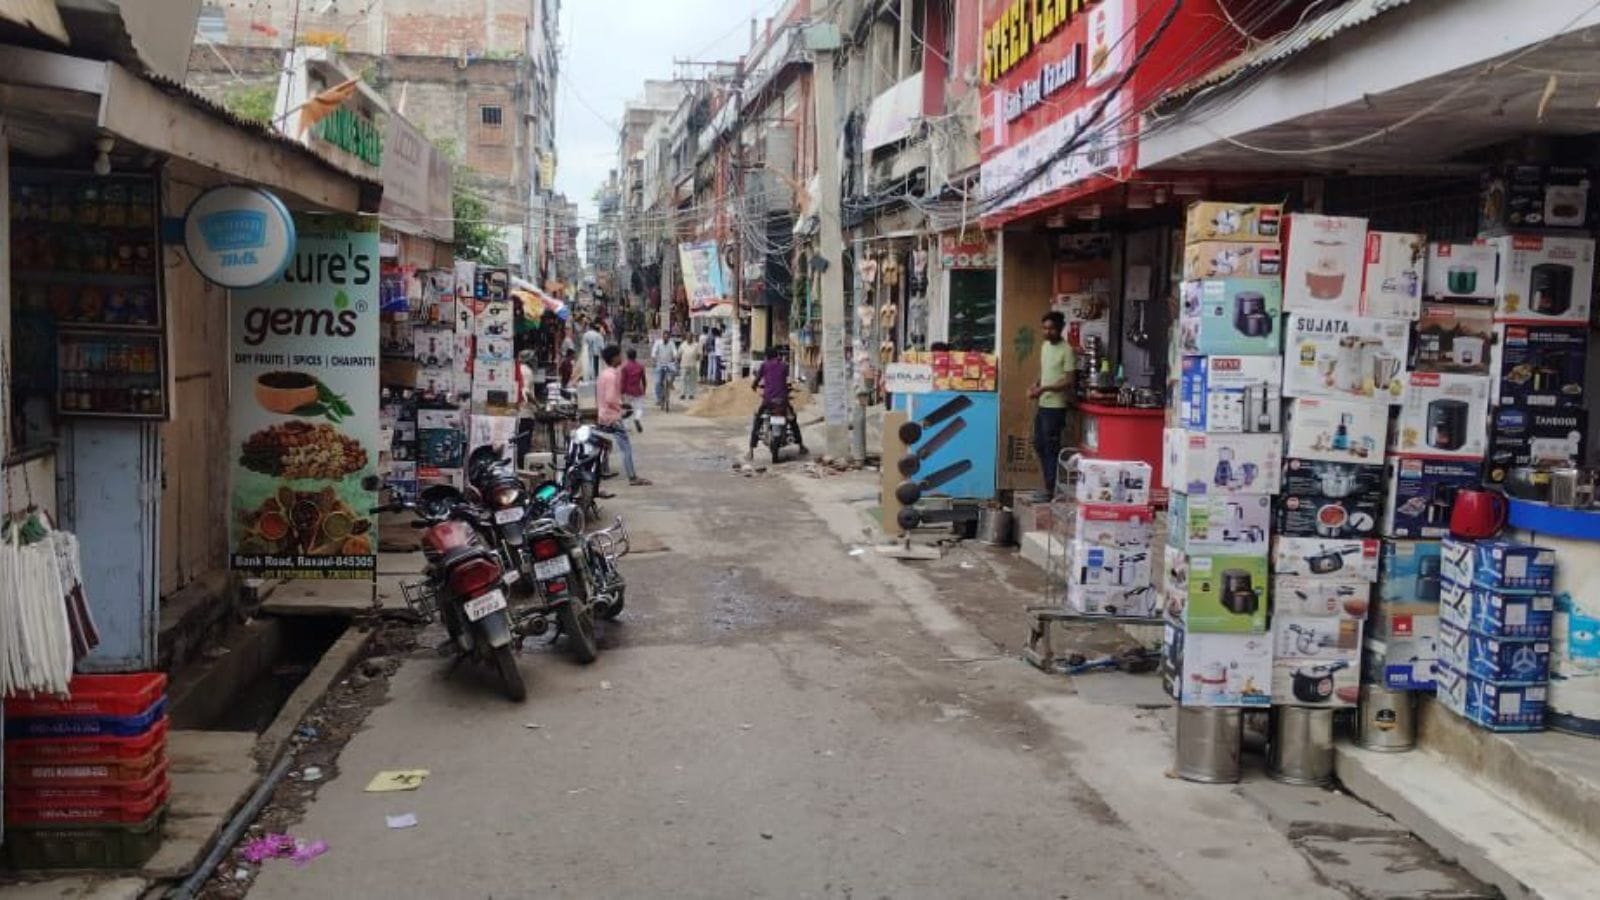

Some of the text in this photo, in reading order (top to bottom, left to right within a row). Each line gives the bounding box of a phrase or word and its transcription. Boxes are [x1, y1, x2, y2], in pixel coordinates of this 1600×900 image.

[243, 305, 358, 346] gems
[1297, 318, 1349, 334] SUJATA
[254, 353, 285, 365] FRUITS
